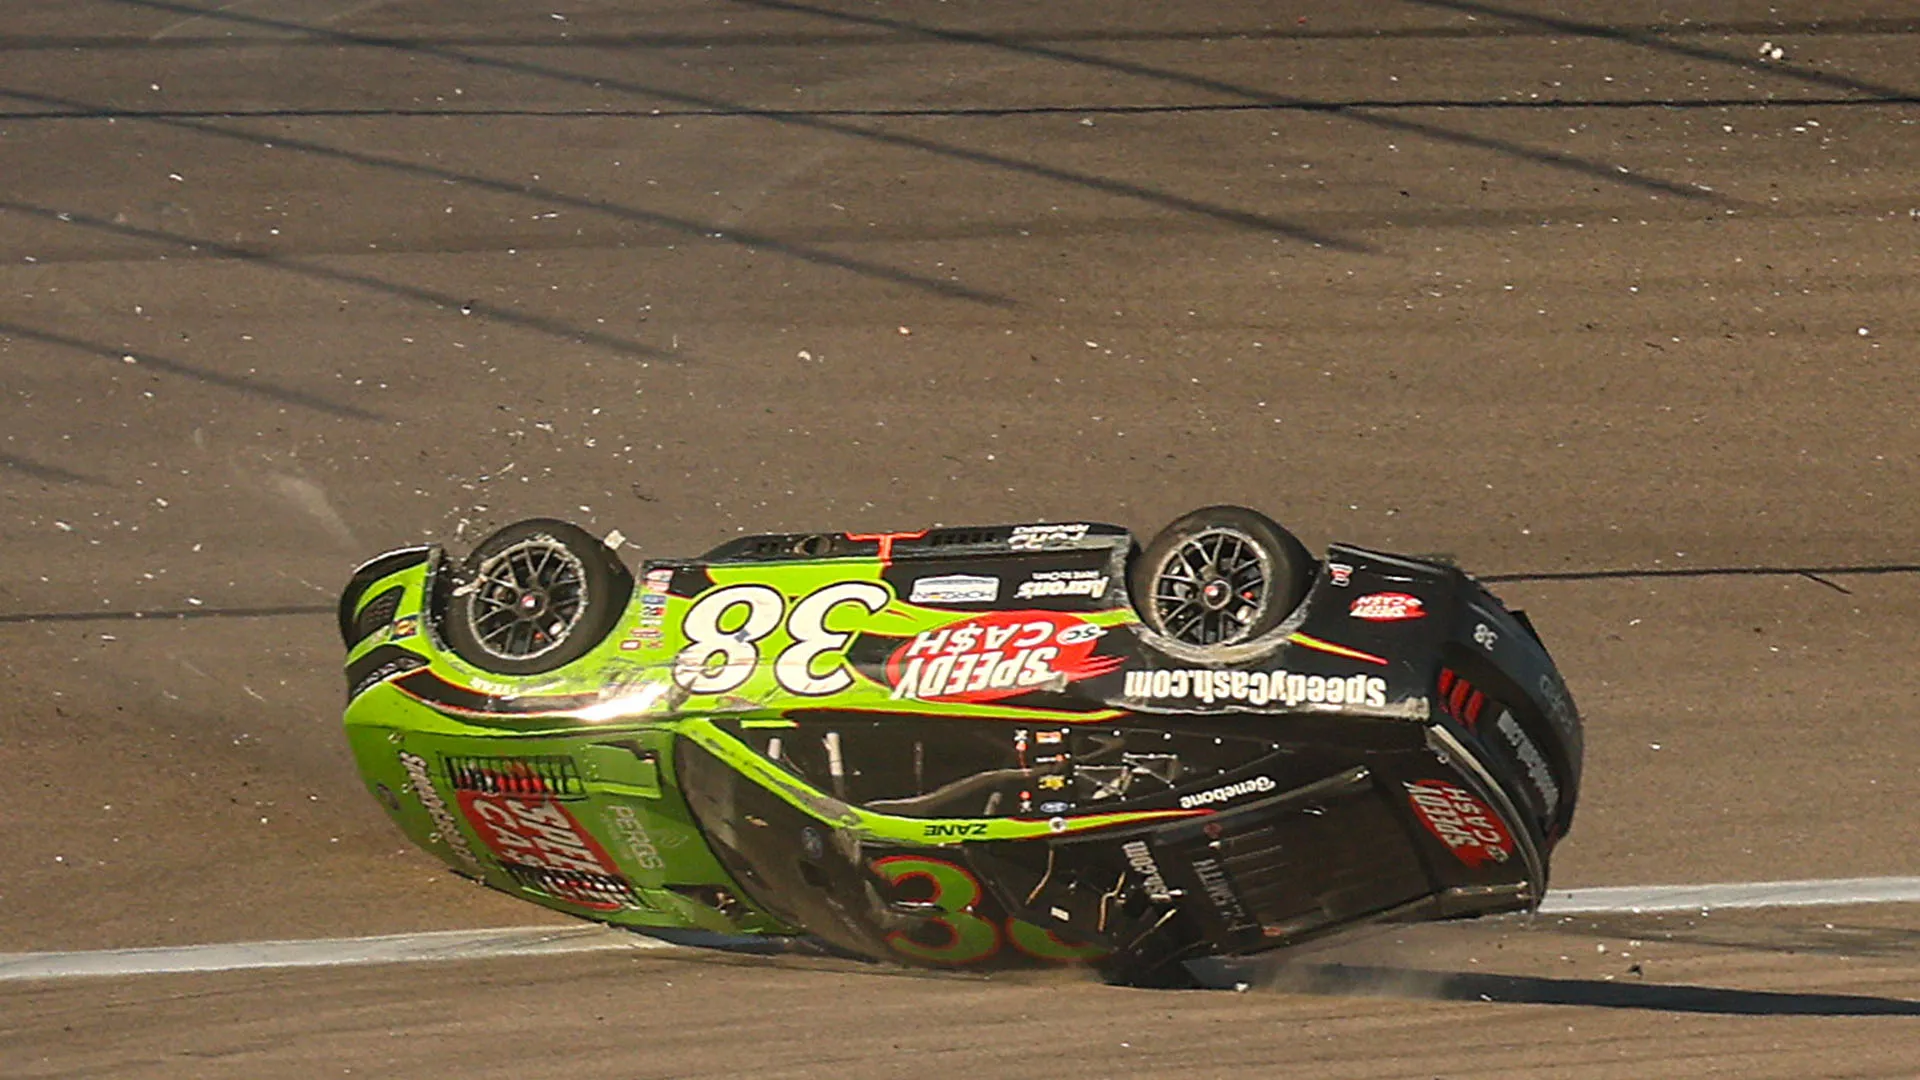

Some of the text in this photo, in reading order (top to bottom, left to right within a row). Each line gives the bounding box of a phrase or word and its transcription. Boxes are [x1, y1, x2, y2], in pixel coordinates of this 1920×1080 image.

[1012, 575, 1110, 598] Aaron's
[672, 578, 891, 696] 38
[906, 620, 1054, 657] CA$H
[1473, 622, 1499, 651] 38
[890, 646, 1063, 700] SPEEDY
[1124, 669, 1387, 707] SpeedyCash.com
[1179, 775, 1277, 809] Benebone
[923, 822, 989, 837] ZANE
[1402, 779, 1482, 849] SPEEDY
